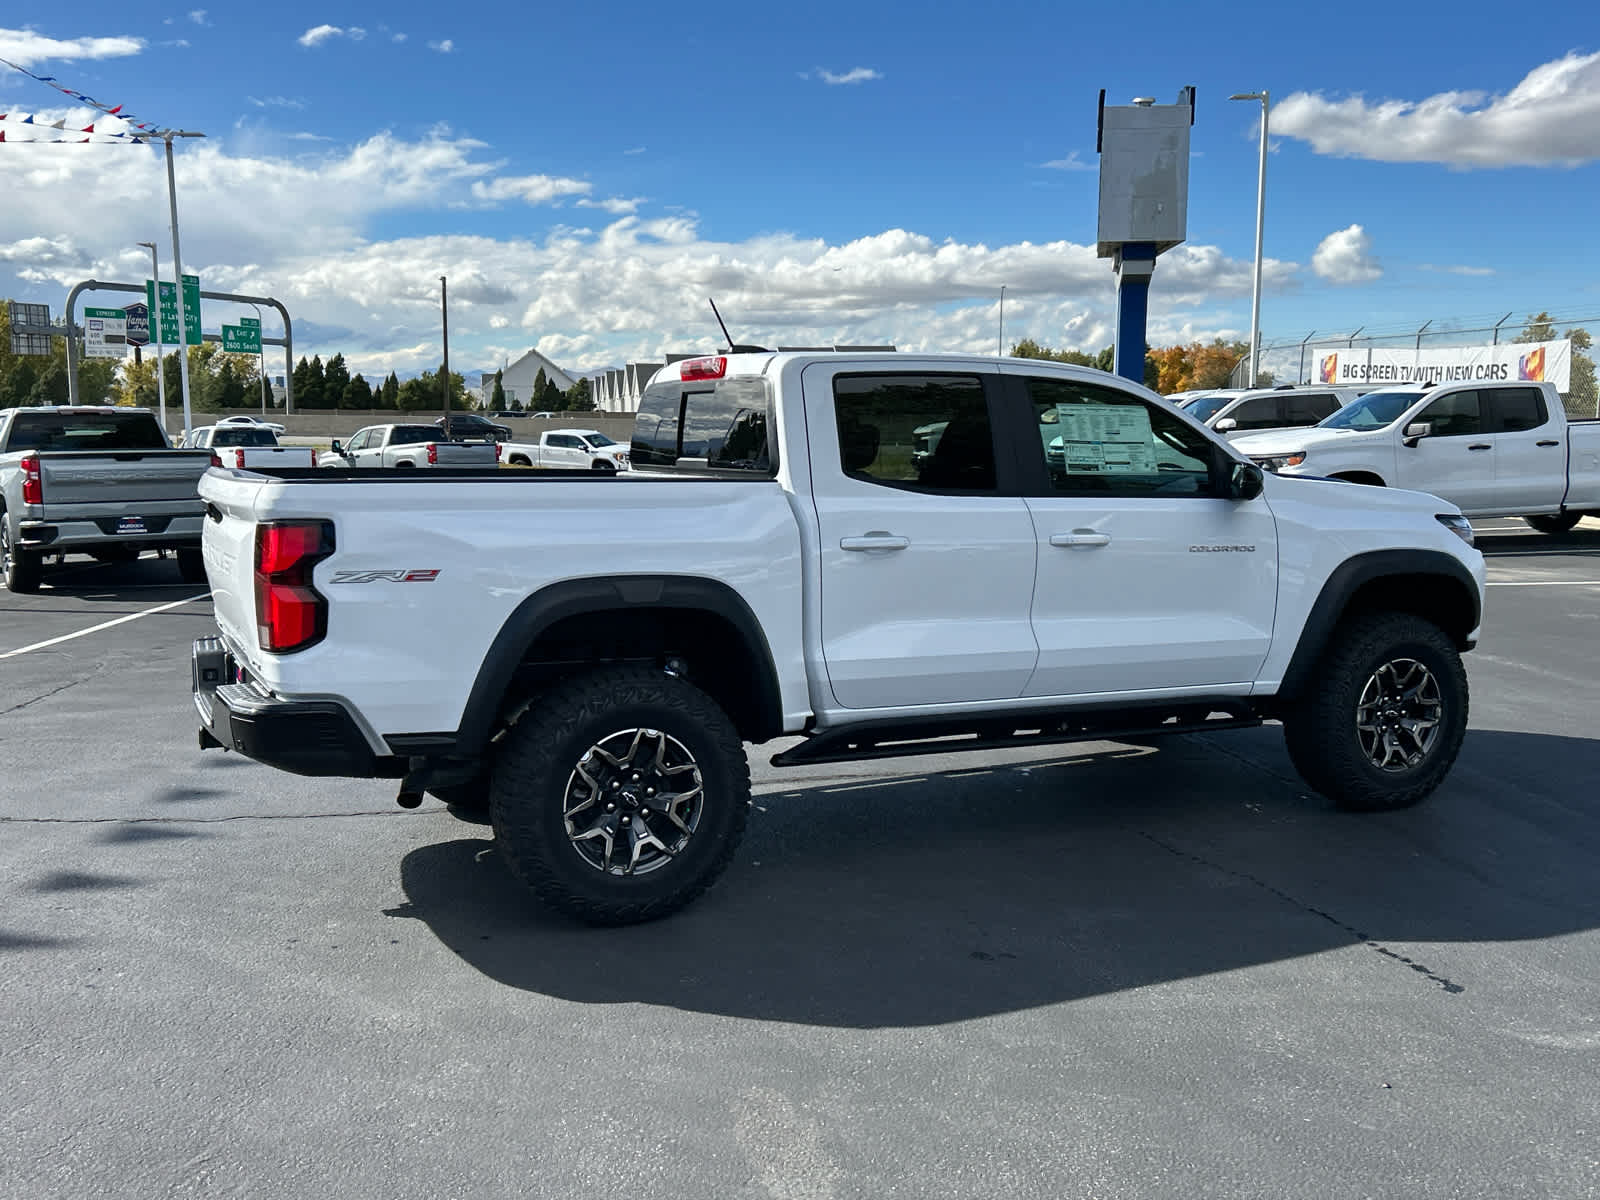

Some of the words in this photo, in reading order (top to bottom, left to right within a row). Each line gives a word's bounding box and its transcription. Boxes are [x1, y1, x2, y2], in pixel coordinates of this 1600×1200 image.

[242, 342, 259, 351] South
[1360, 364, 1398, 380] SCREEN
[1400, 366, 1413, 380] TV
[1413, 365, 1442, 382] WITH
[1445, 365, 1473, 381] NEW
[1476, 363, 1508, 380] CARS
[1188, 545, 1256, 553] COLORADO
[329, 569, 442, 584] ZR2
